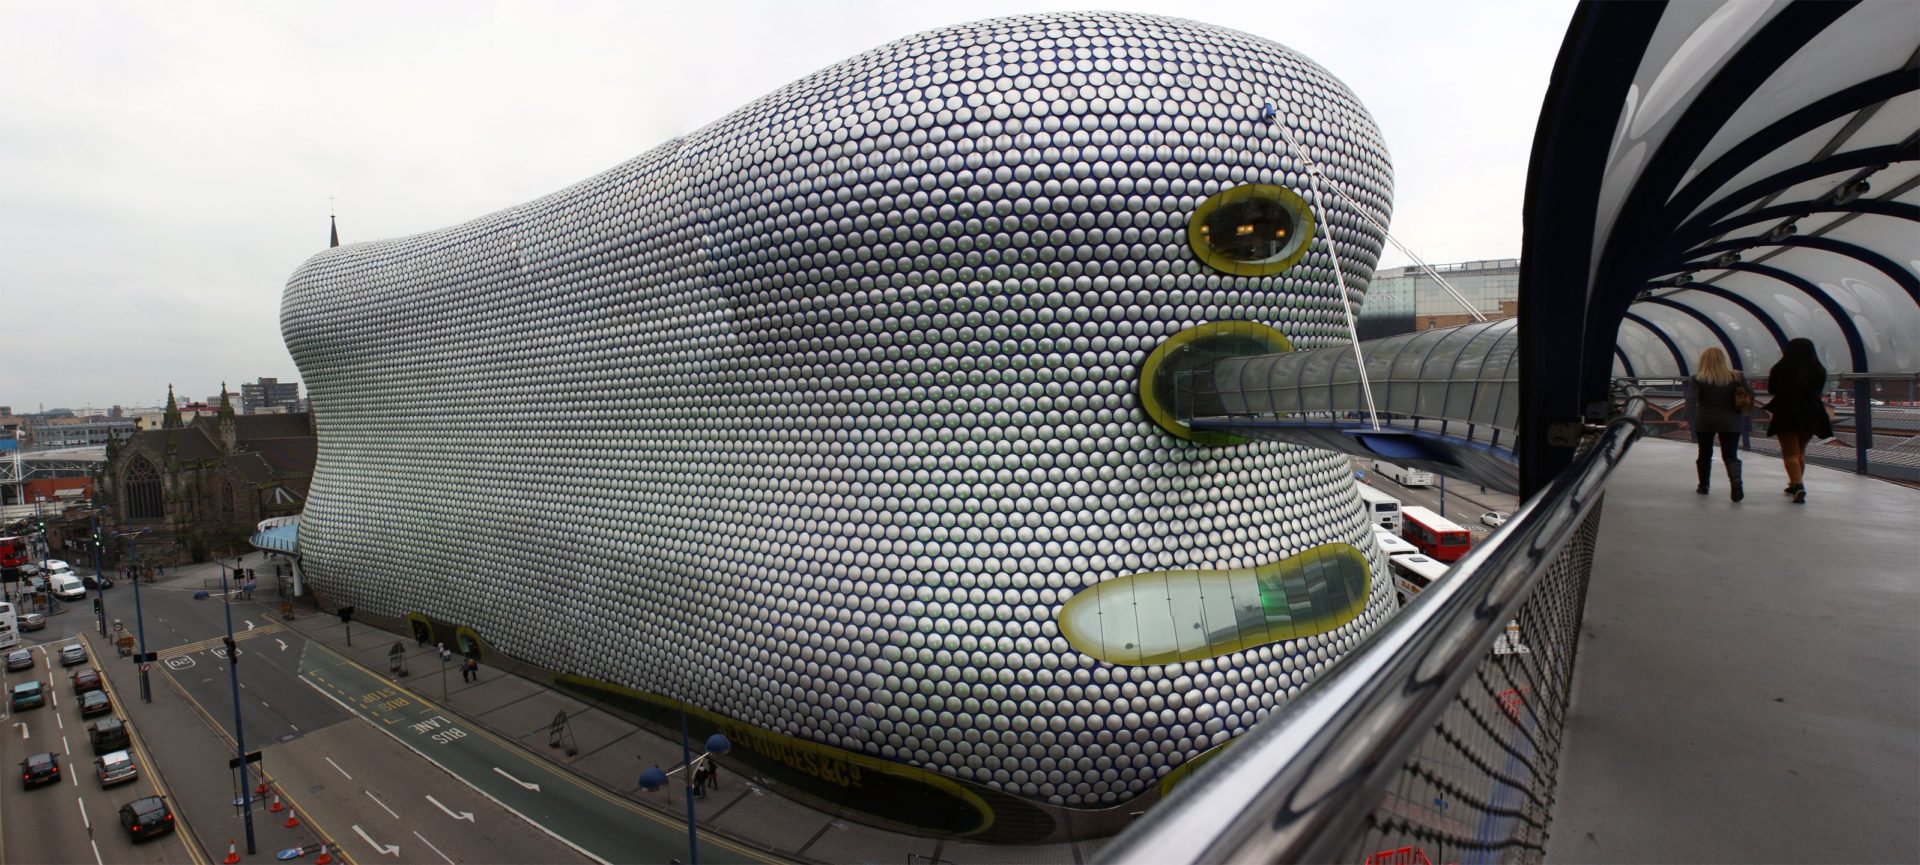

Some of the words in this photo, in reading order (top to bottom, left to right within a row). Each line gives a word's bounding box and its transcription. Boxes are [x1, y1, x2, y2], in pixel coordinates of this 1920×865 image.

[170, 657, 190, 667] 20
[362, 687, 396, 704] STOP
[378, 697, 410, 712] BUS
[408, 715, 451, 735] LANE
[431, 727, 468, 744] BUS
